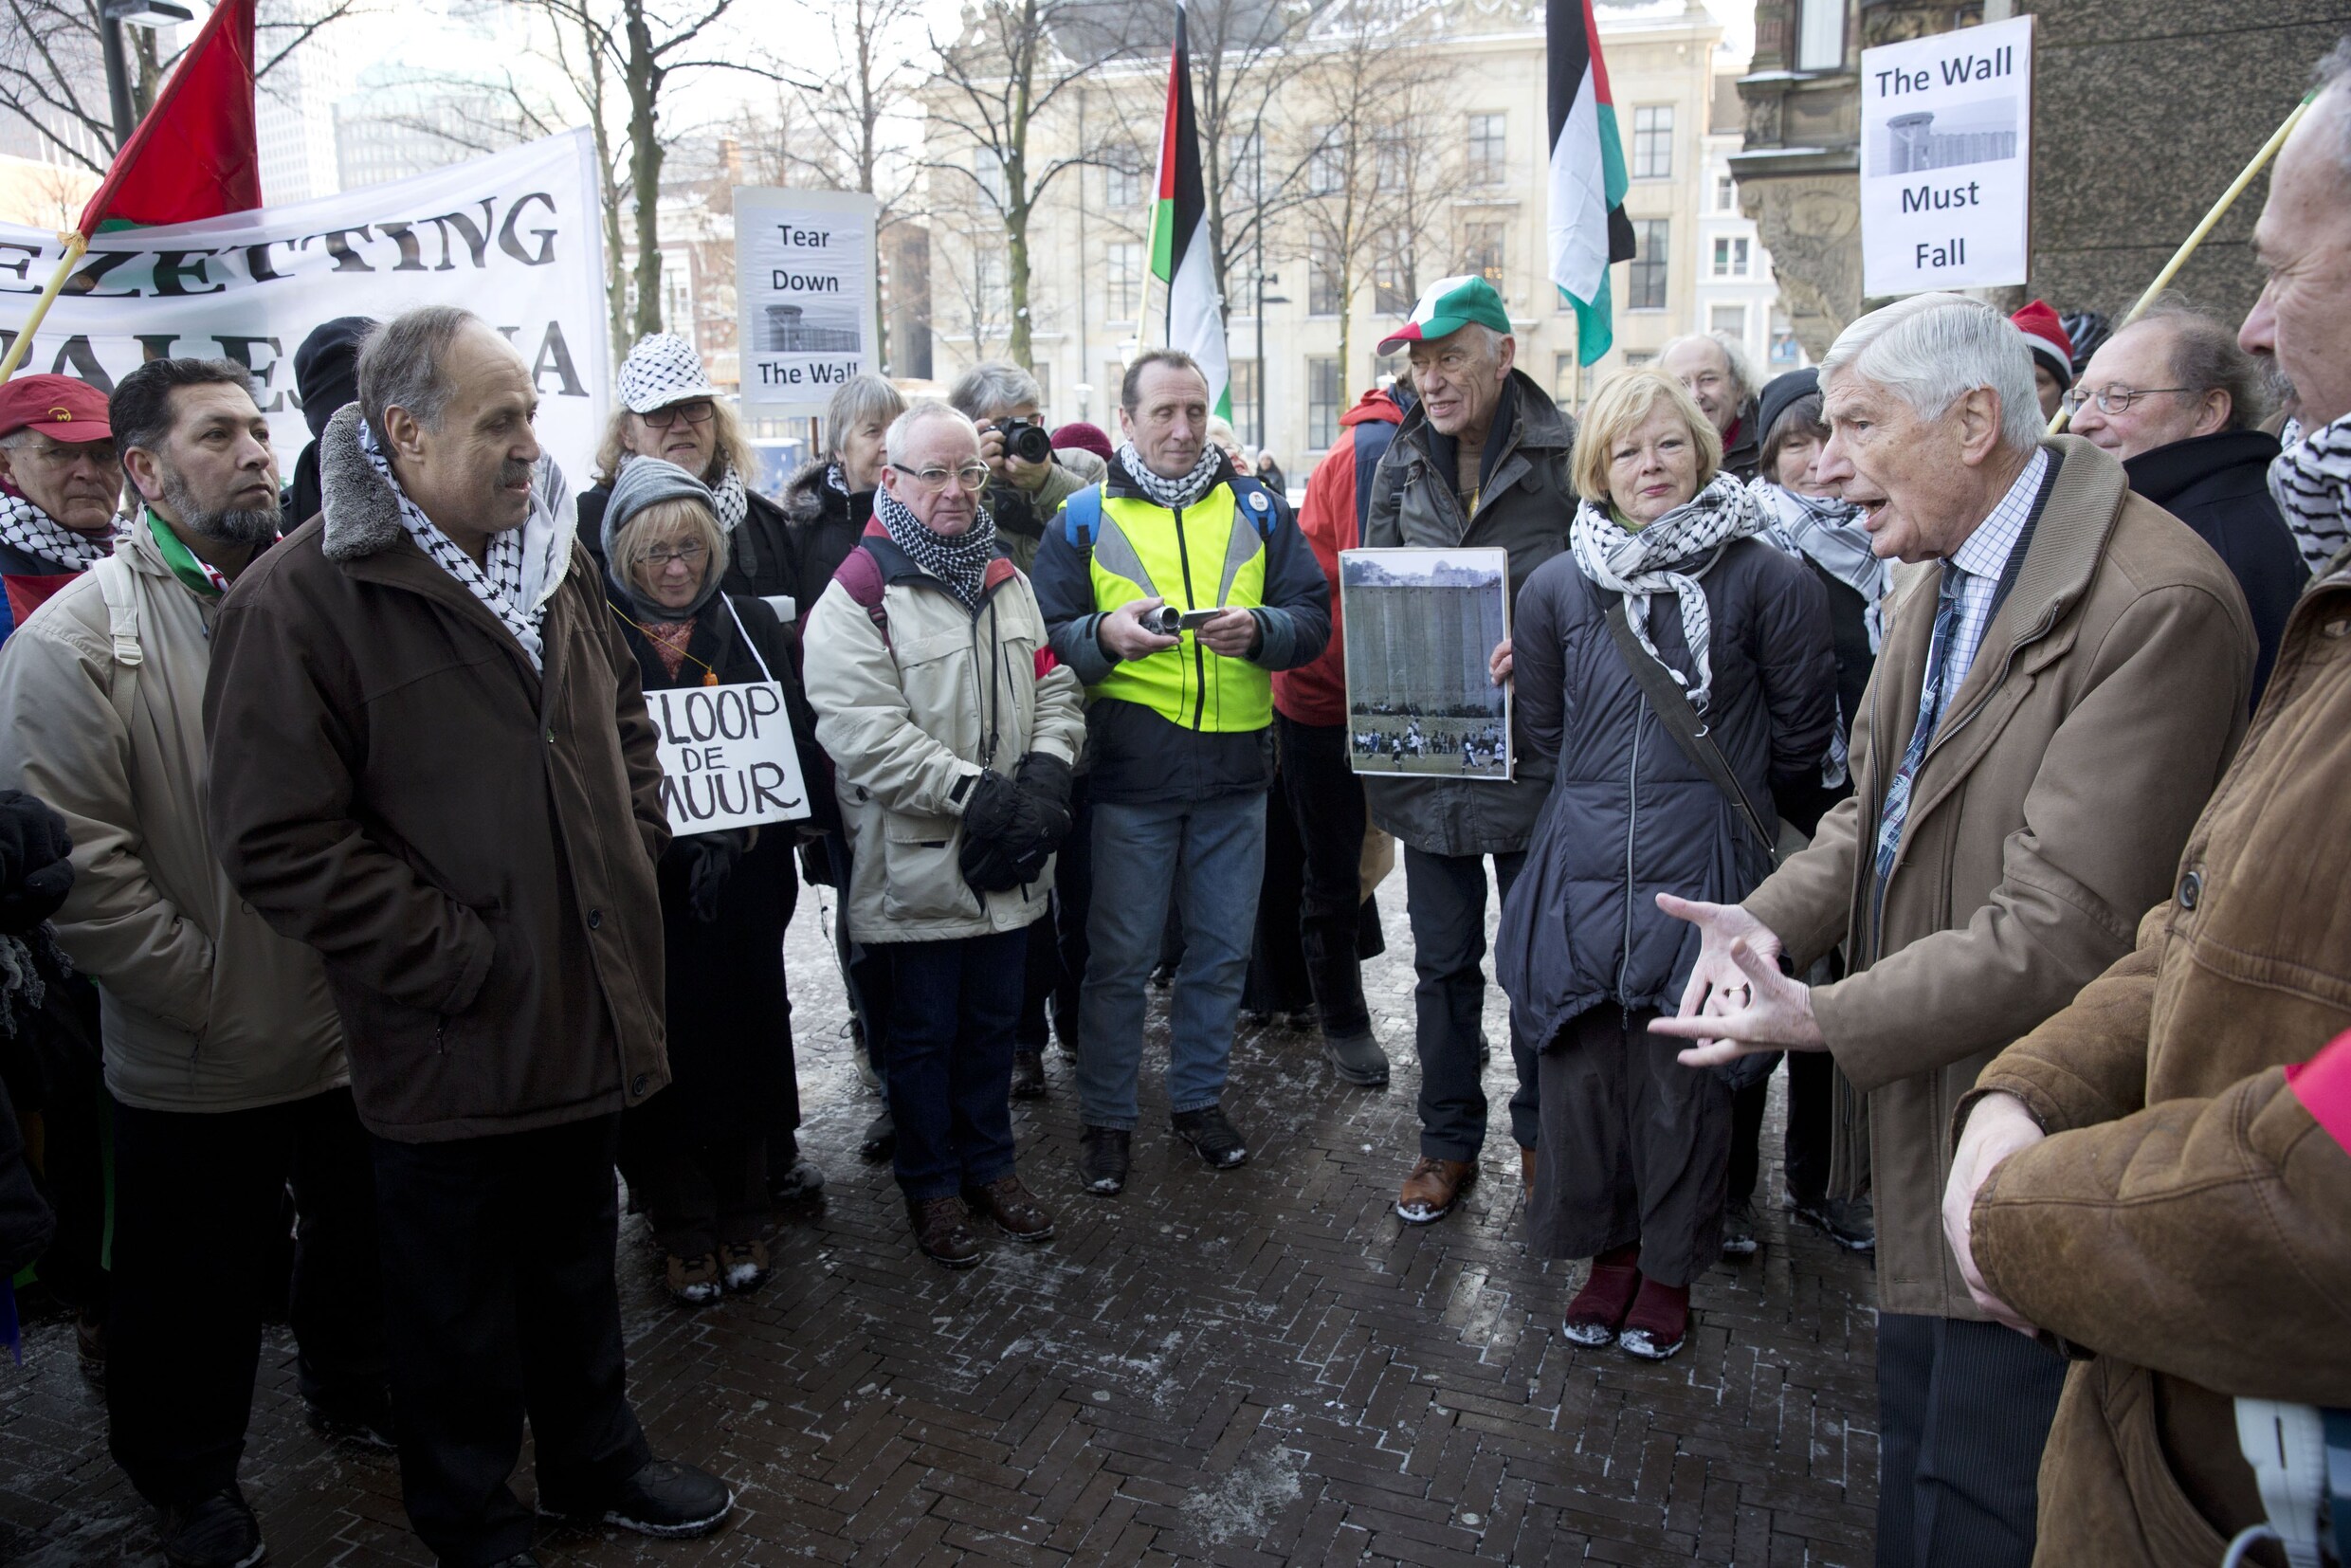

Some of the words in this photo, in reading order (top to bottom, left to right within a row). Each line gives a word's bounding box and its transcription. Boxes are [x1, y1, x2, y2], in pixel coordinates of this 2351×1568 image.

[1876, 68, 1930, 97] The
[1941, 46, 2012, 86] Wall
[1902, 181, 1979, 213] Must
[777, 225, 829, 247] Tear
[1916, 238, 1965, 268] Fall
[773, 269, 839, 292] Down
[758, 362, 802, 384] The
[809, 362, 858, 384] Wall
[682, 746, 730, 773] DE
